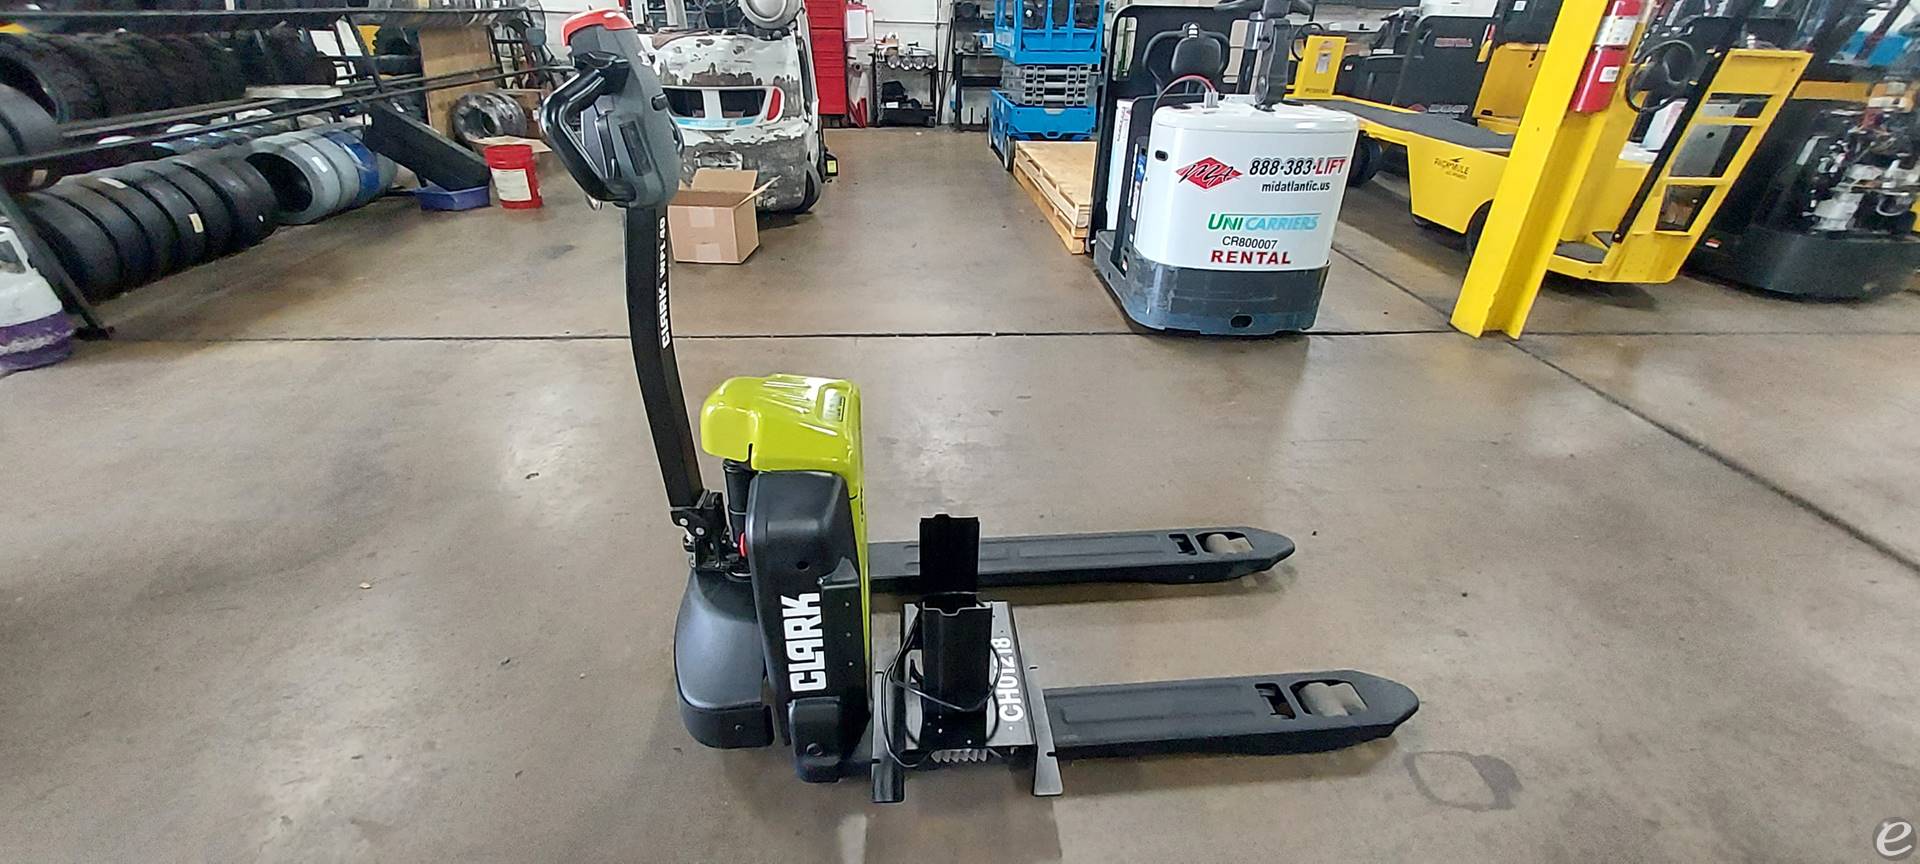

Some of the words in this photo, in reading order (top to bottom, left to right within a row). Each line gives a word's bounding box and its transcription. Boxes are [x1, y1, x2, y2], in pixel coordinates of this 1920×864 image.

[1261, 180, 1330, 192] midatlantic.us
[1222, 235, 1278, 250] CR800007
[1210, 250, 1291, 265] RENTAL
[659, 281, 670, 350] CLARK
[781, 592, 827, 693] CLARK
